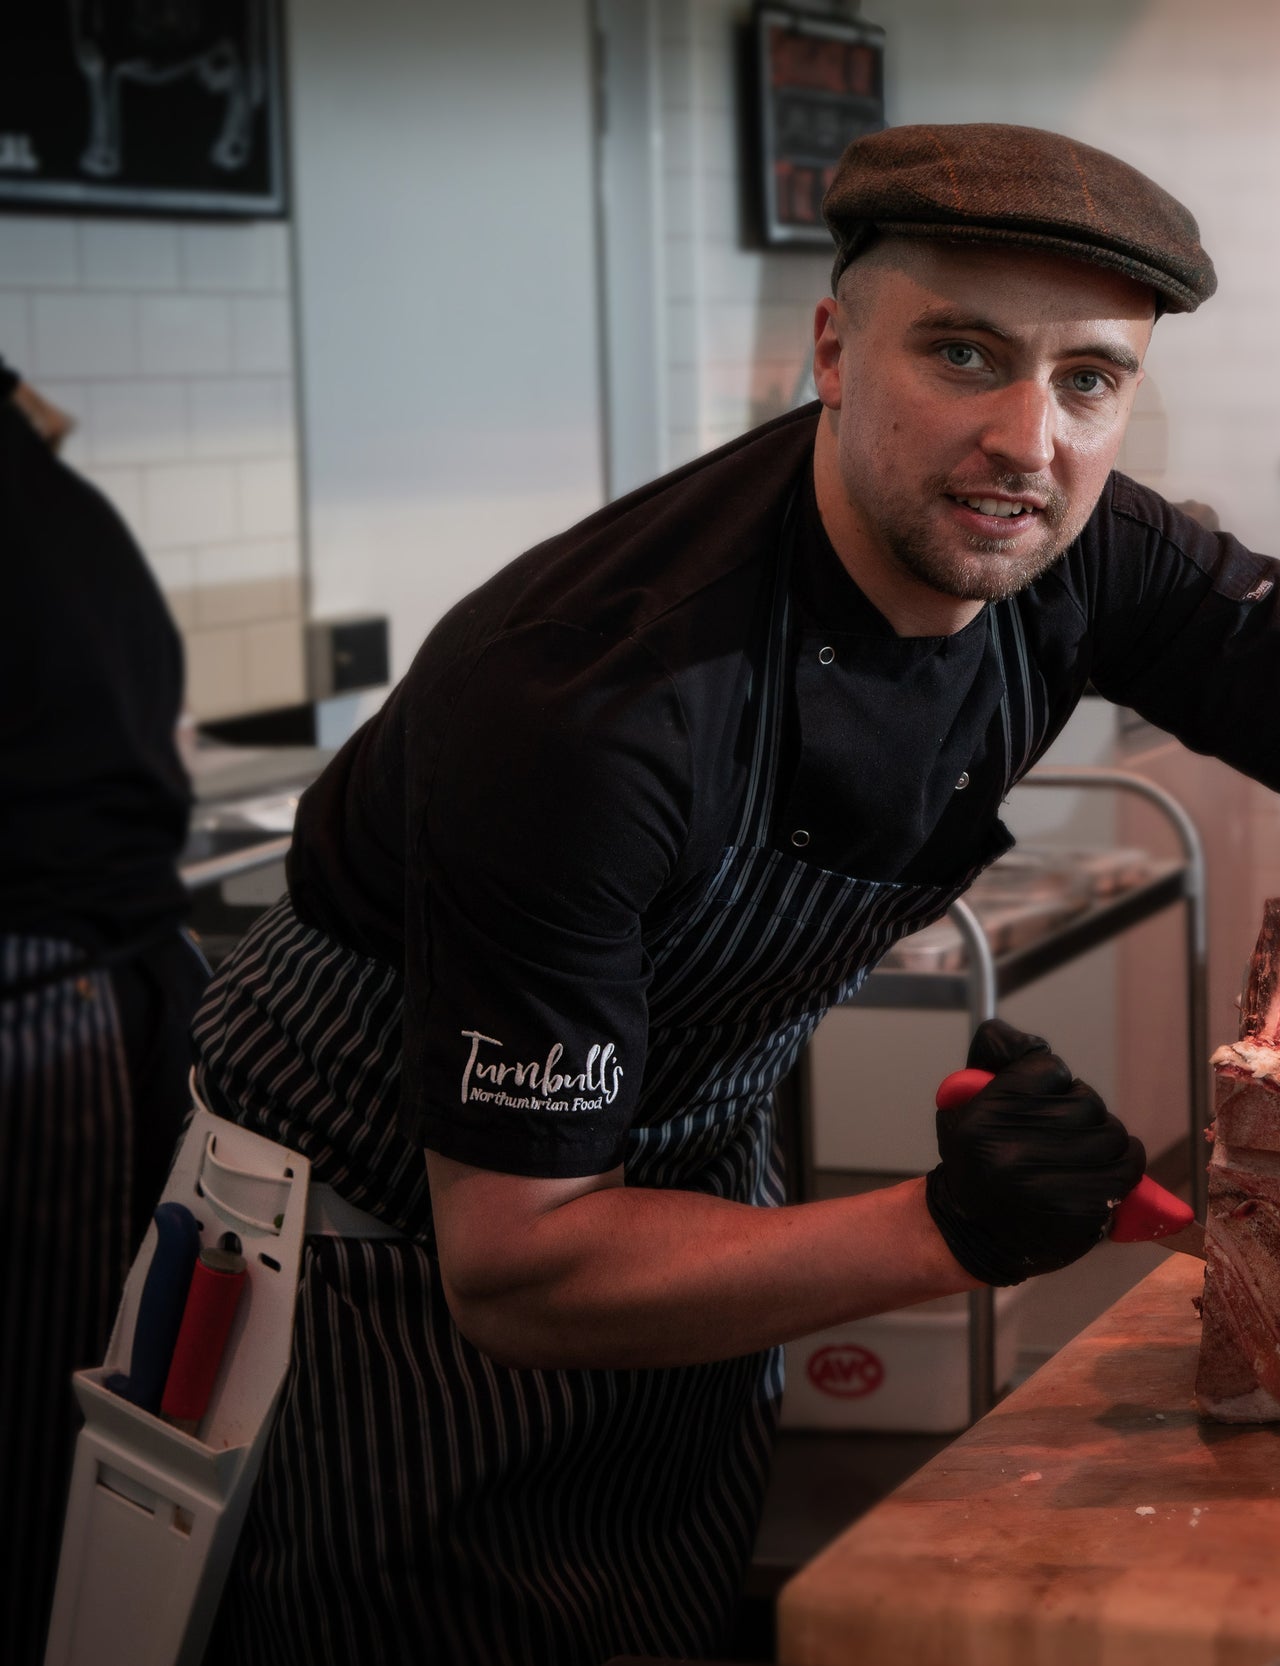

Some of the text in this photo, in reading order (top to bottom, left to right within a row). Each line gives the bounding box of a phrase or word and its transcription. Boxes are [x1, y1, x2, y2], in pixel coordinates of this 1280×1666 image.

[461, 1030, 624, 1104] Turnbull's
[469, 1087, 603, 1111] Northumbrian Food
